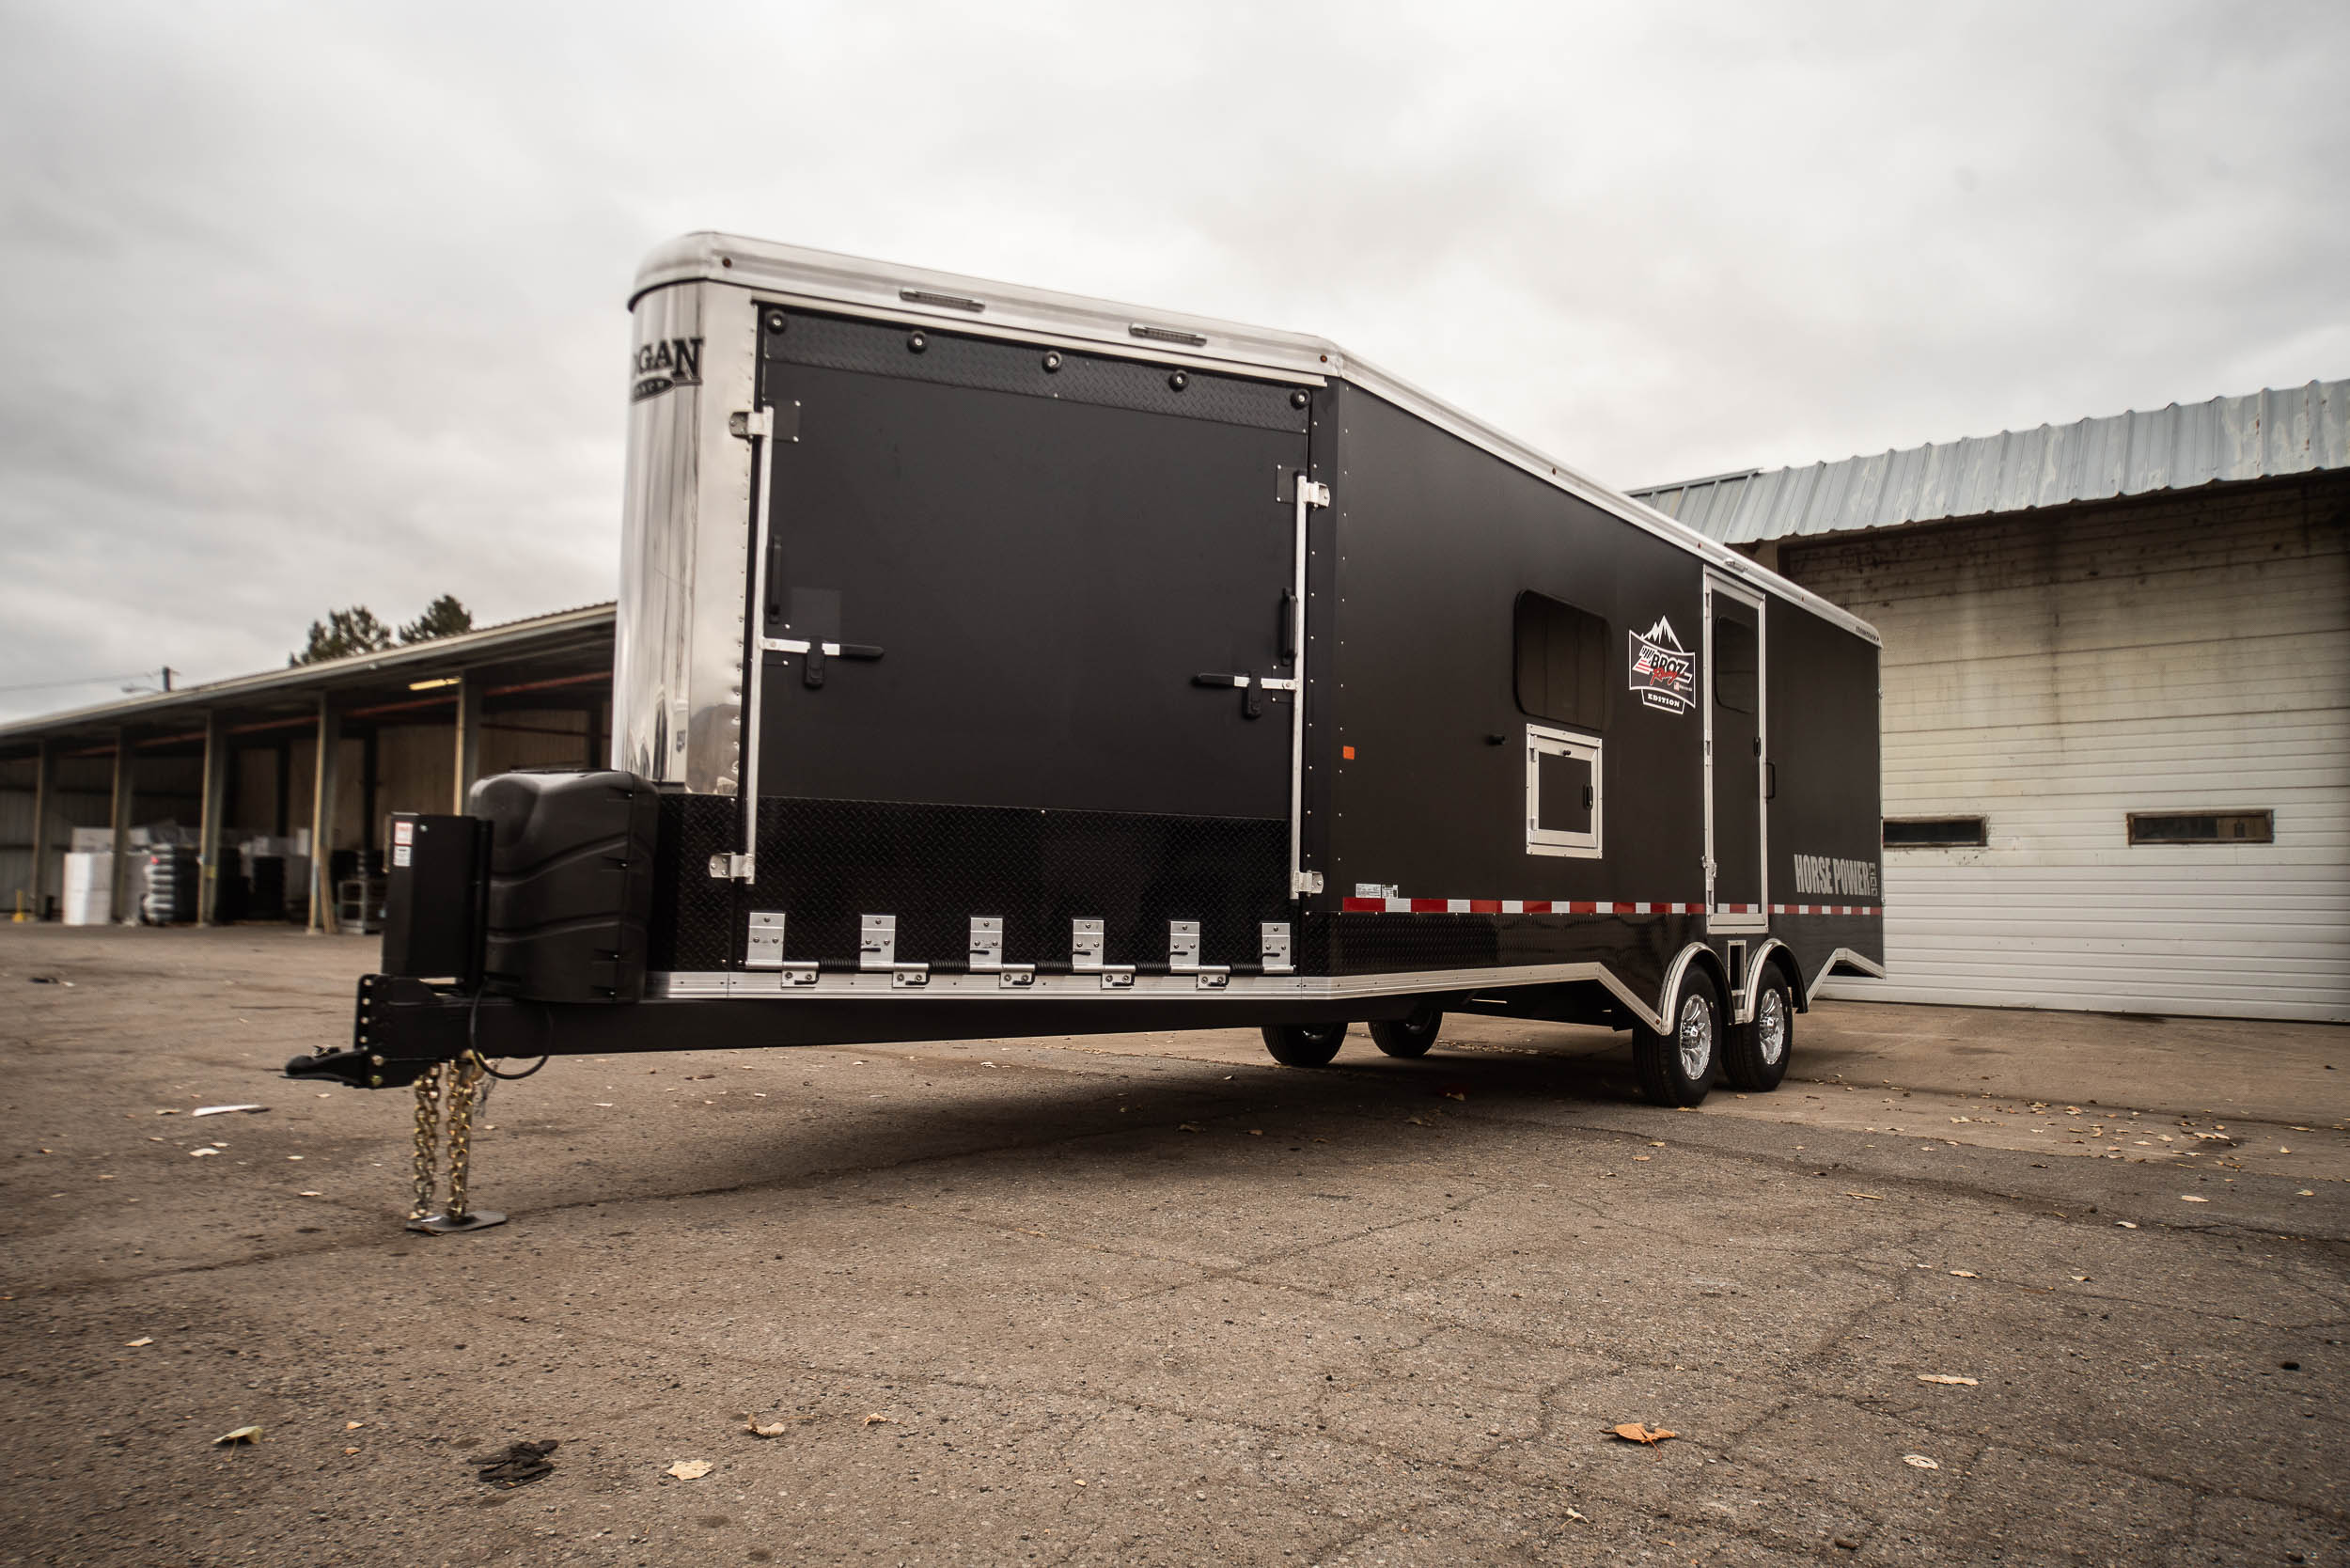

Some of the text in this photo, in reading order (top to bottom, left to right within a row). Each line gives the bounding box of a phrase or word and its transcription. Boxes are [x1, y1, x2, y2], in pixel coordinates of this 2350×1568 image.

[1647, 693, 1681, 707] EDITION
[1794, 854, 1871, 895] HORSE POWER
